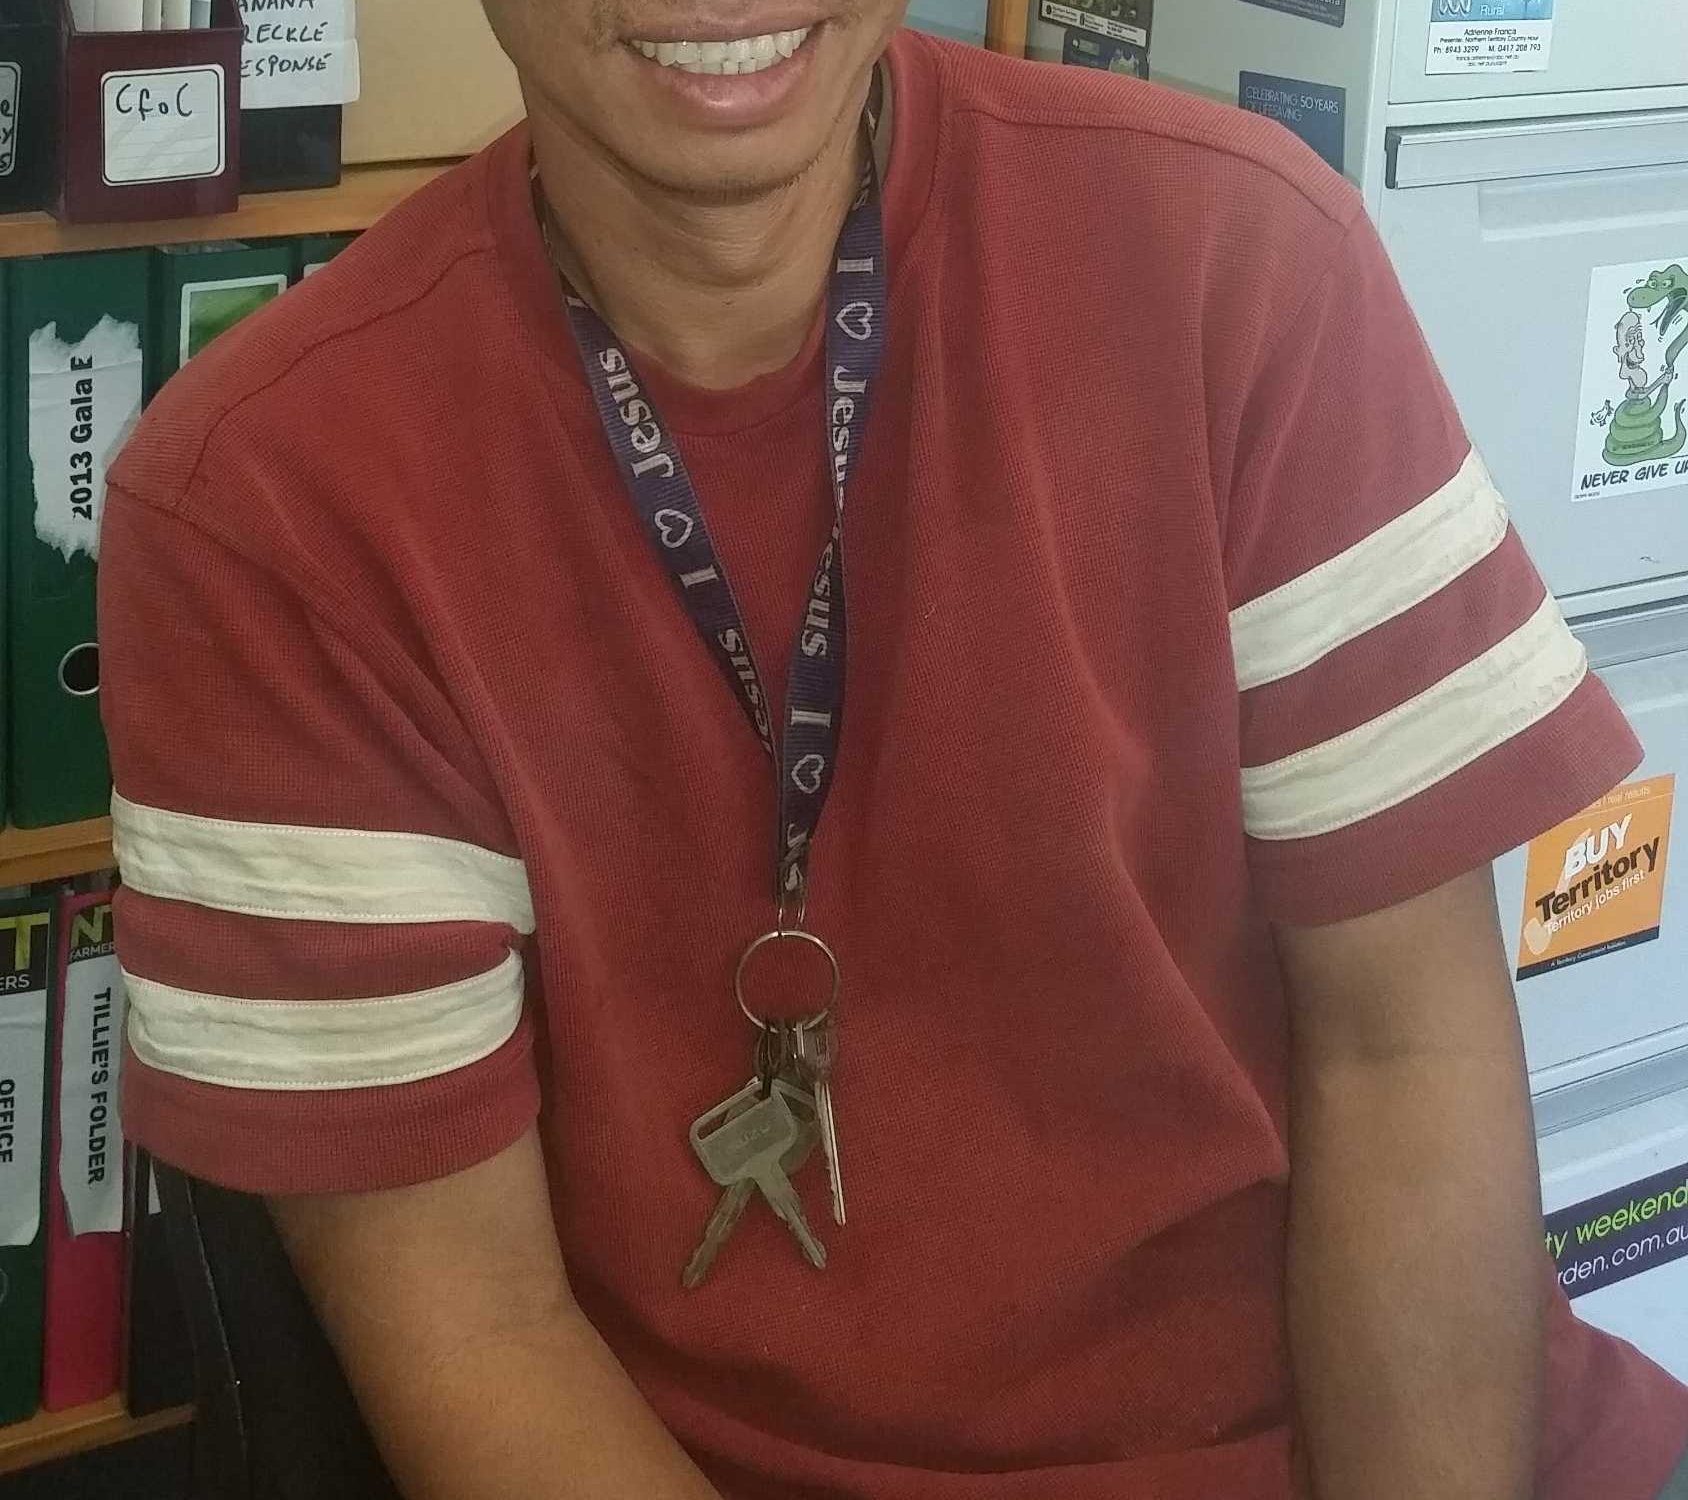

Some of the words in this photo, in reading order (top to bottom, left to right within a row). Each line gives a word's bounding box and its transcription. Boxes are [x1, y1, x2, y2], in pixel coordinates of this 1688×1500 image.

[241, 21, 329, 46] RECKLE
[1480, 4, 1505, 16] Rural
[240, 52, 333, 79] ESPONSE
[1245, 86, 1298, 105] CELEBRATING
[1300, 95, 1314, 109] 50
[1313, 98, 1339, 114] YEARS
[836, 256, 875, 275] I
[70, 381, 94, 443] Gala
[599, 348, 675, 479] Jesus
[70, 451, 94, 520] 2013
[1580, 469, 1630, 490] NEVER
[1634, 463, 1669, 481] GIVE
[801, 526, 838, 657] esus
[718, 628, 773, 754] esus
[1564, 812, 1633, 881] BUY
[1535, 836, 1661, 923] Territory
[1546, 901, 1593, 934] Territory
[1622, 869, 1645, 891] first
[89, 986, 112, 1086] TILLIE'S
[87, 1095, 109, 1186] FOLDER
[1545, 1231, 1568, 1260] ty
[1557, 1224, 1688, 1285] rden.com.au
